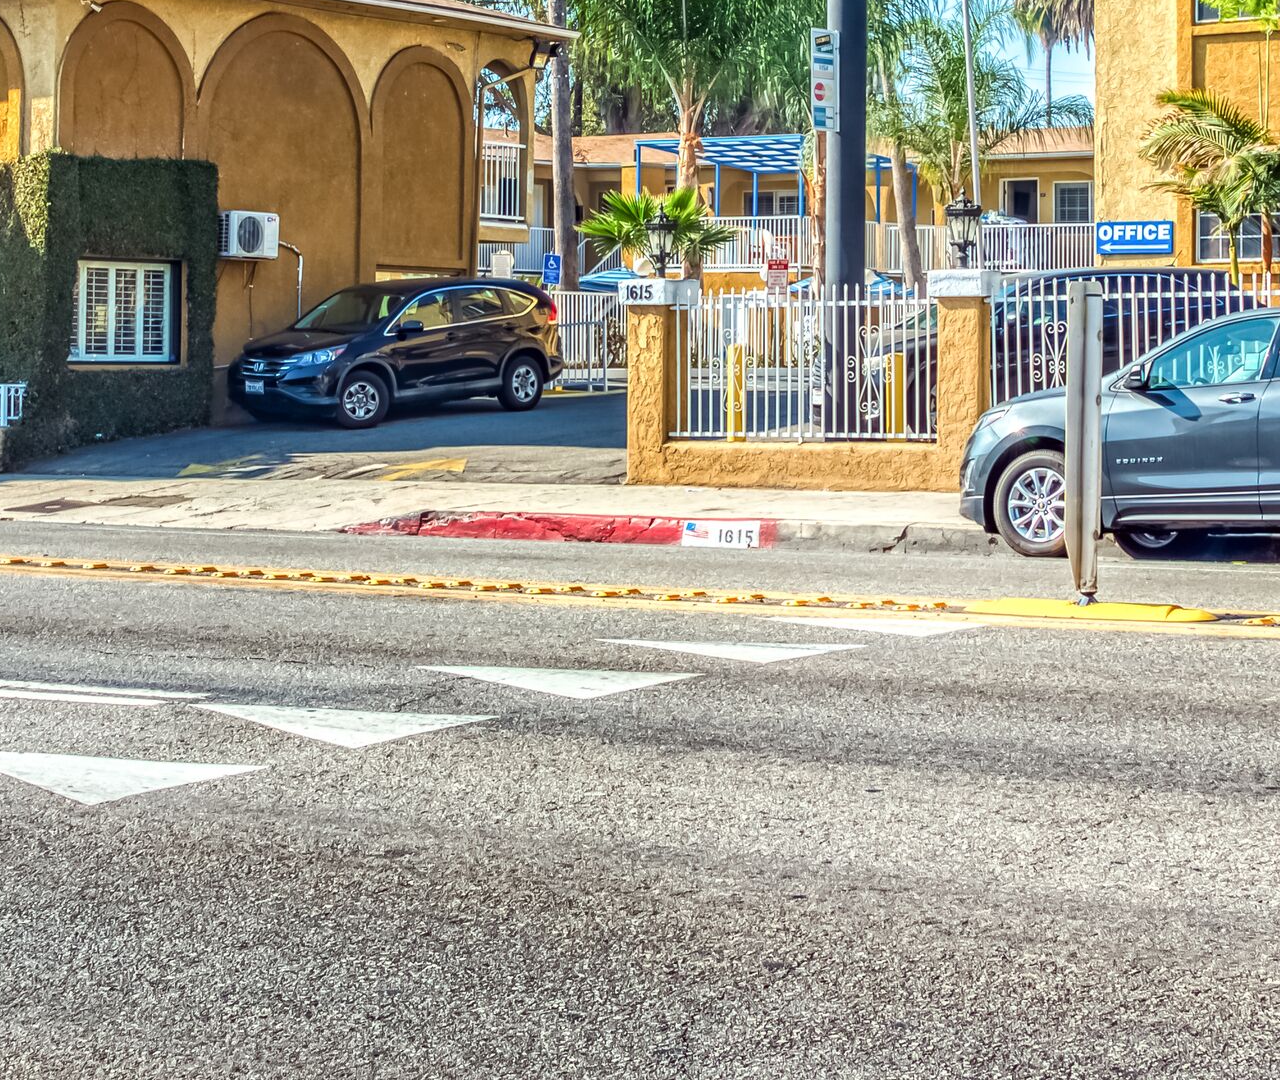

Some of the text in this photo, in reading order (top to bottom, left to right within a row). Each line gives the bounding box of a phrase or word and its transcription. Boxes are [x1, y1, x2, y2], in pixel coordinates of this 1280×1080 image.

[1098, 224, 1170, 241] OFFICE
[626, 284, 653, 301] 1615
[1116, 456, 1163, 464] EQUINOX
[719, 529, 753, 548] 1615
